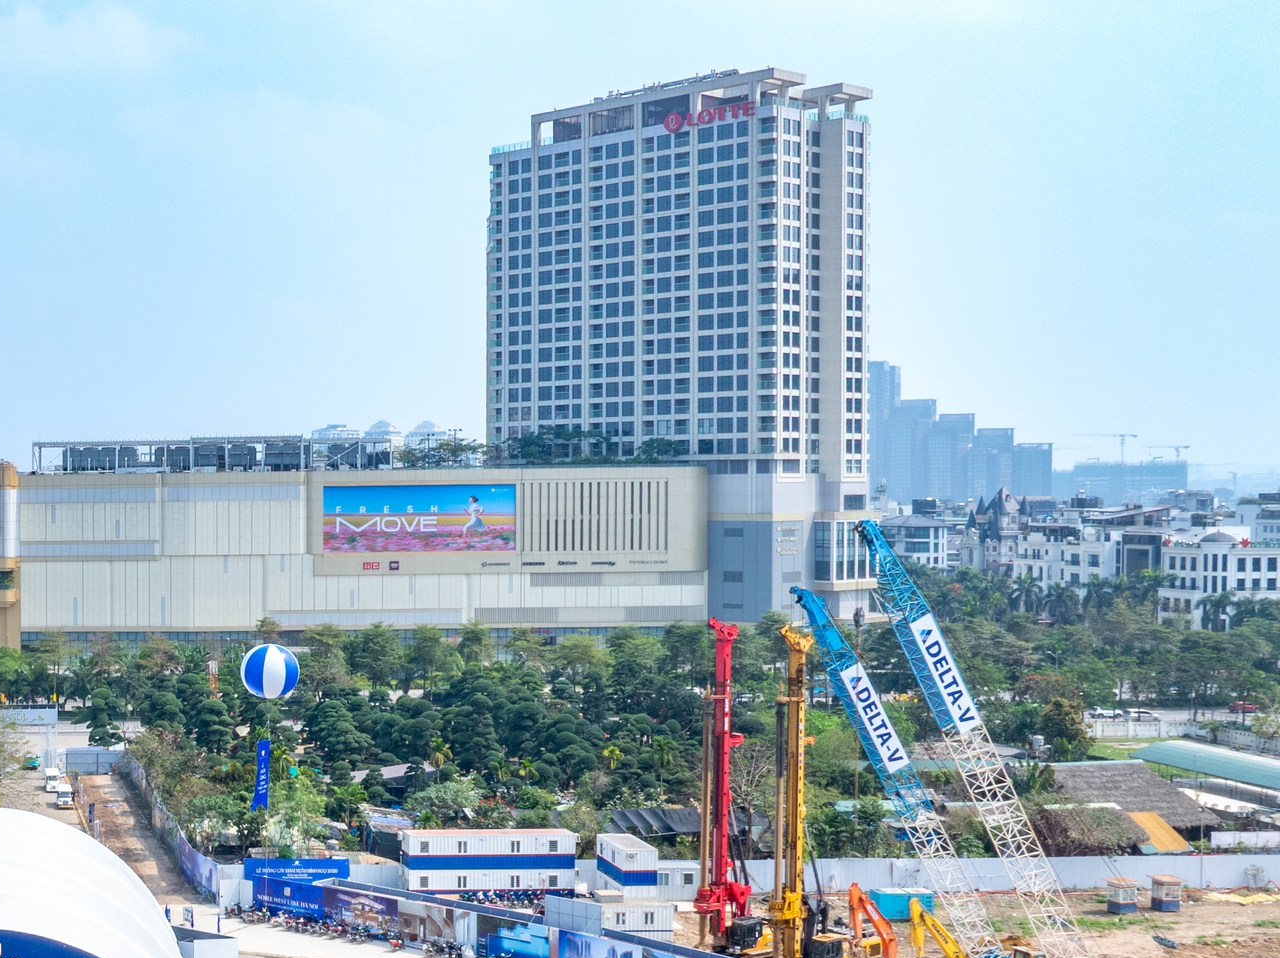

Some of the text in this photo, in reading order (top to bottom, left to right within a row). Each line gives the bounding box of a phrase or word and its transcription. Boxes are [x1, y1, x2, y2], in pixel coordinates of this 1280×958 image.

[686, 100, 756, 127] LOTTE
[335, 505, 438, 514] FRESH
[335, 516, 438, 532] MOVE
[925, 640, 976, 723] DELTA-V
[855, 686, 904, 763] DELTA-V
